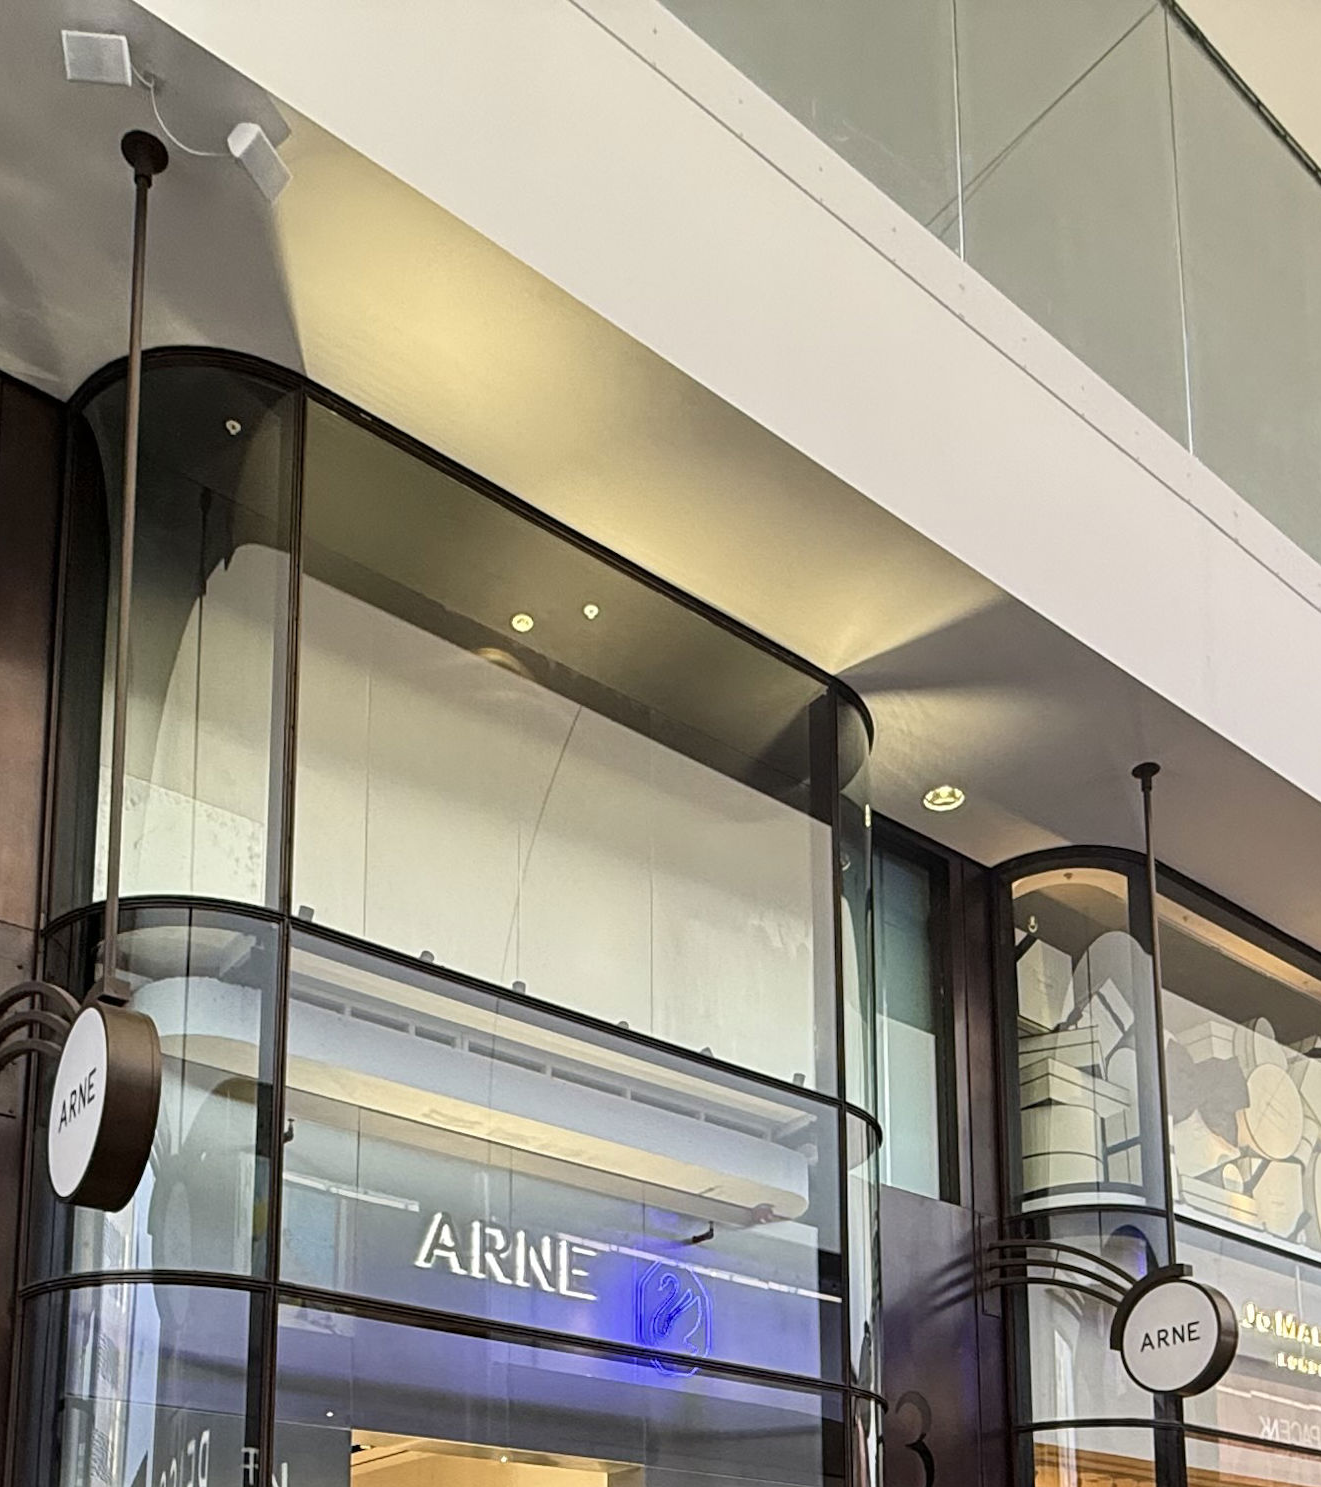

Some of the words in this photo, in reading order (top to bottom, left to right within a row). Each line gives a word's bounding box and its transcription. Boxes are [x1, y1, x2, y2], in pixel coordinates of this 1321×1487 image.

[57, 1067, 97, 1132] ARNE
[414, 1211, 599, 1301] ARNE
[1140, 1321, 1201, 1353] ARNE
